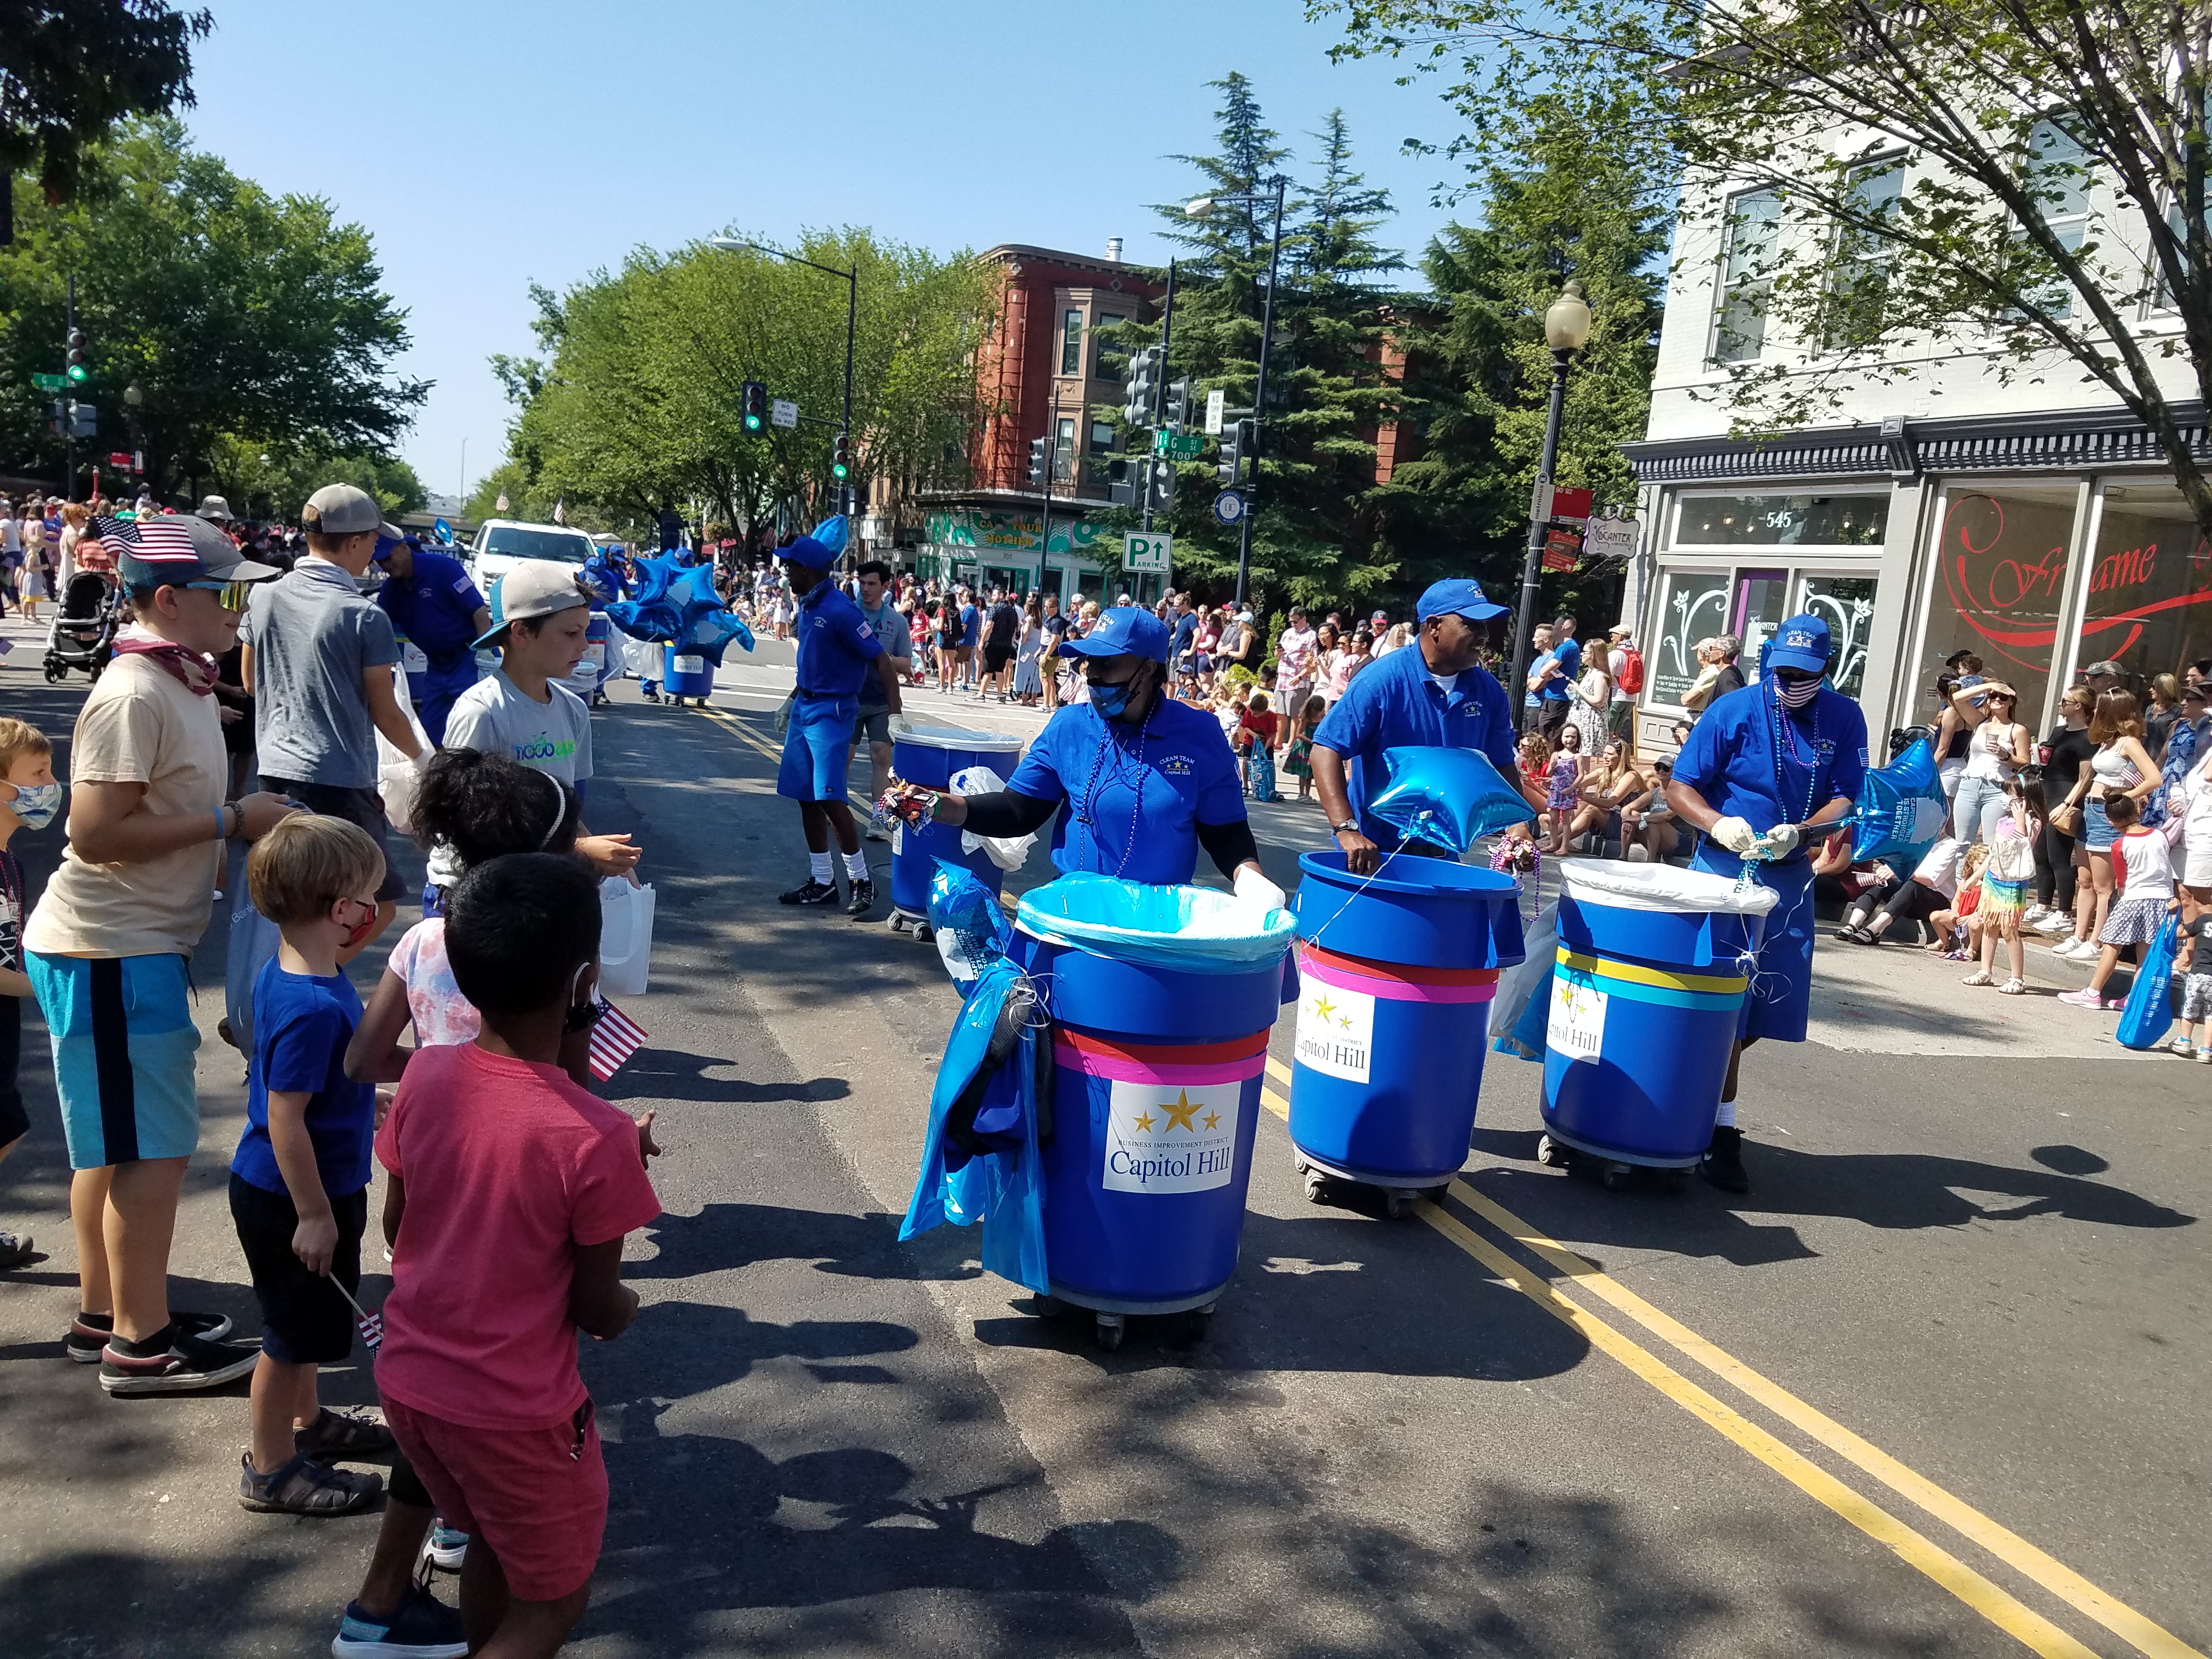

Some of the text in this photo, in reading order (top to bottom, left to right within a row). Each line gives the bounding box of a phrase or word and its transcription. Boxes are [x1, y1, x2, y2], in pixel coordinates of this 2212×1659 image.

[1171, 437, 1178, 449] G
[1171, 451, 1190, 460] 700
[1224, 503, 1236, 512] DC
[1535, 484, 1544, 520] metrobus
[1012, 522, 1042, 533] YOUR
[1766, 511, 1793, 528] 545
[986, 535, 1032, 548] MOTHER
[1102, 614, 1115, 626] TEAM
[1802, 630, 1818, 640] TEAM
[1159, 755, 1195, 765] CLEAN TEAM
[1891, 800, 1903, 839] TOGETHER
[1897, 806, 1910, 842] STRONGER
[1903, 797, 1916, 843] CAPITOL HILL
[231, 904, 253, 923] Bank
[960, 929, 984, 969] STRONGER
[967, 931, 988, 969] OGETHER
[964, 946, 980, 981] CAPITOL
[1548, 1022, 1597, 1052] apitol Hill
[1296, 1029, 1365, 1070] Capitol Hill
[1118, 1139, 1152, 1148] BUSINESS
[1204, 1136, 1229, 1146] DISTRICT
[1110, 1146, 1231, 1184] Capitol Hill
